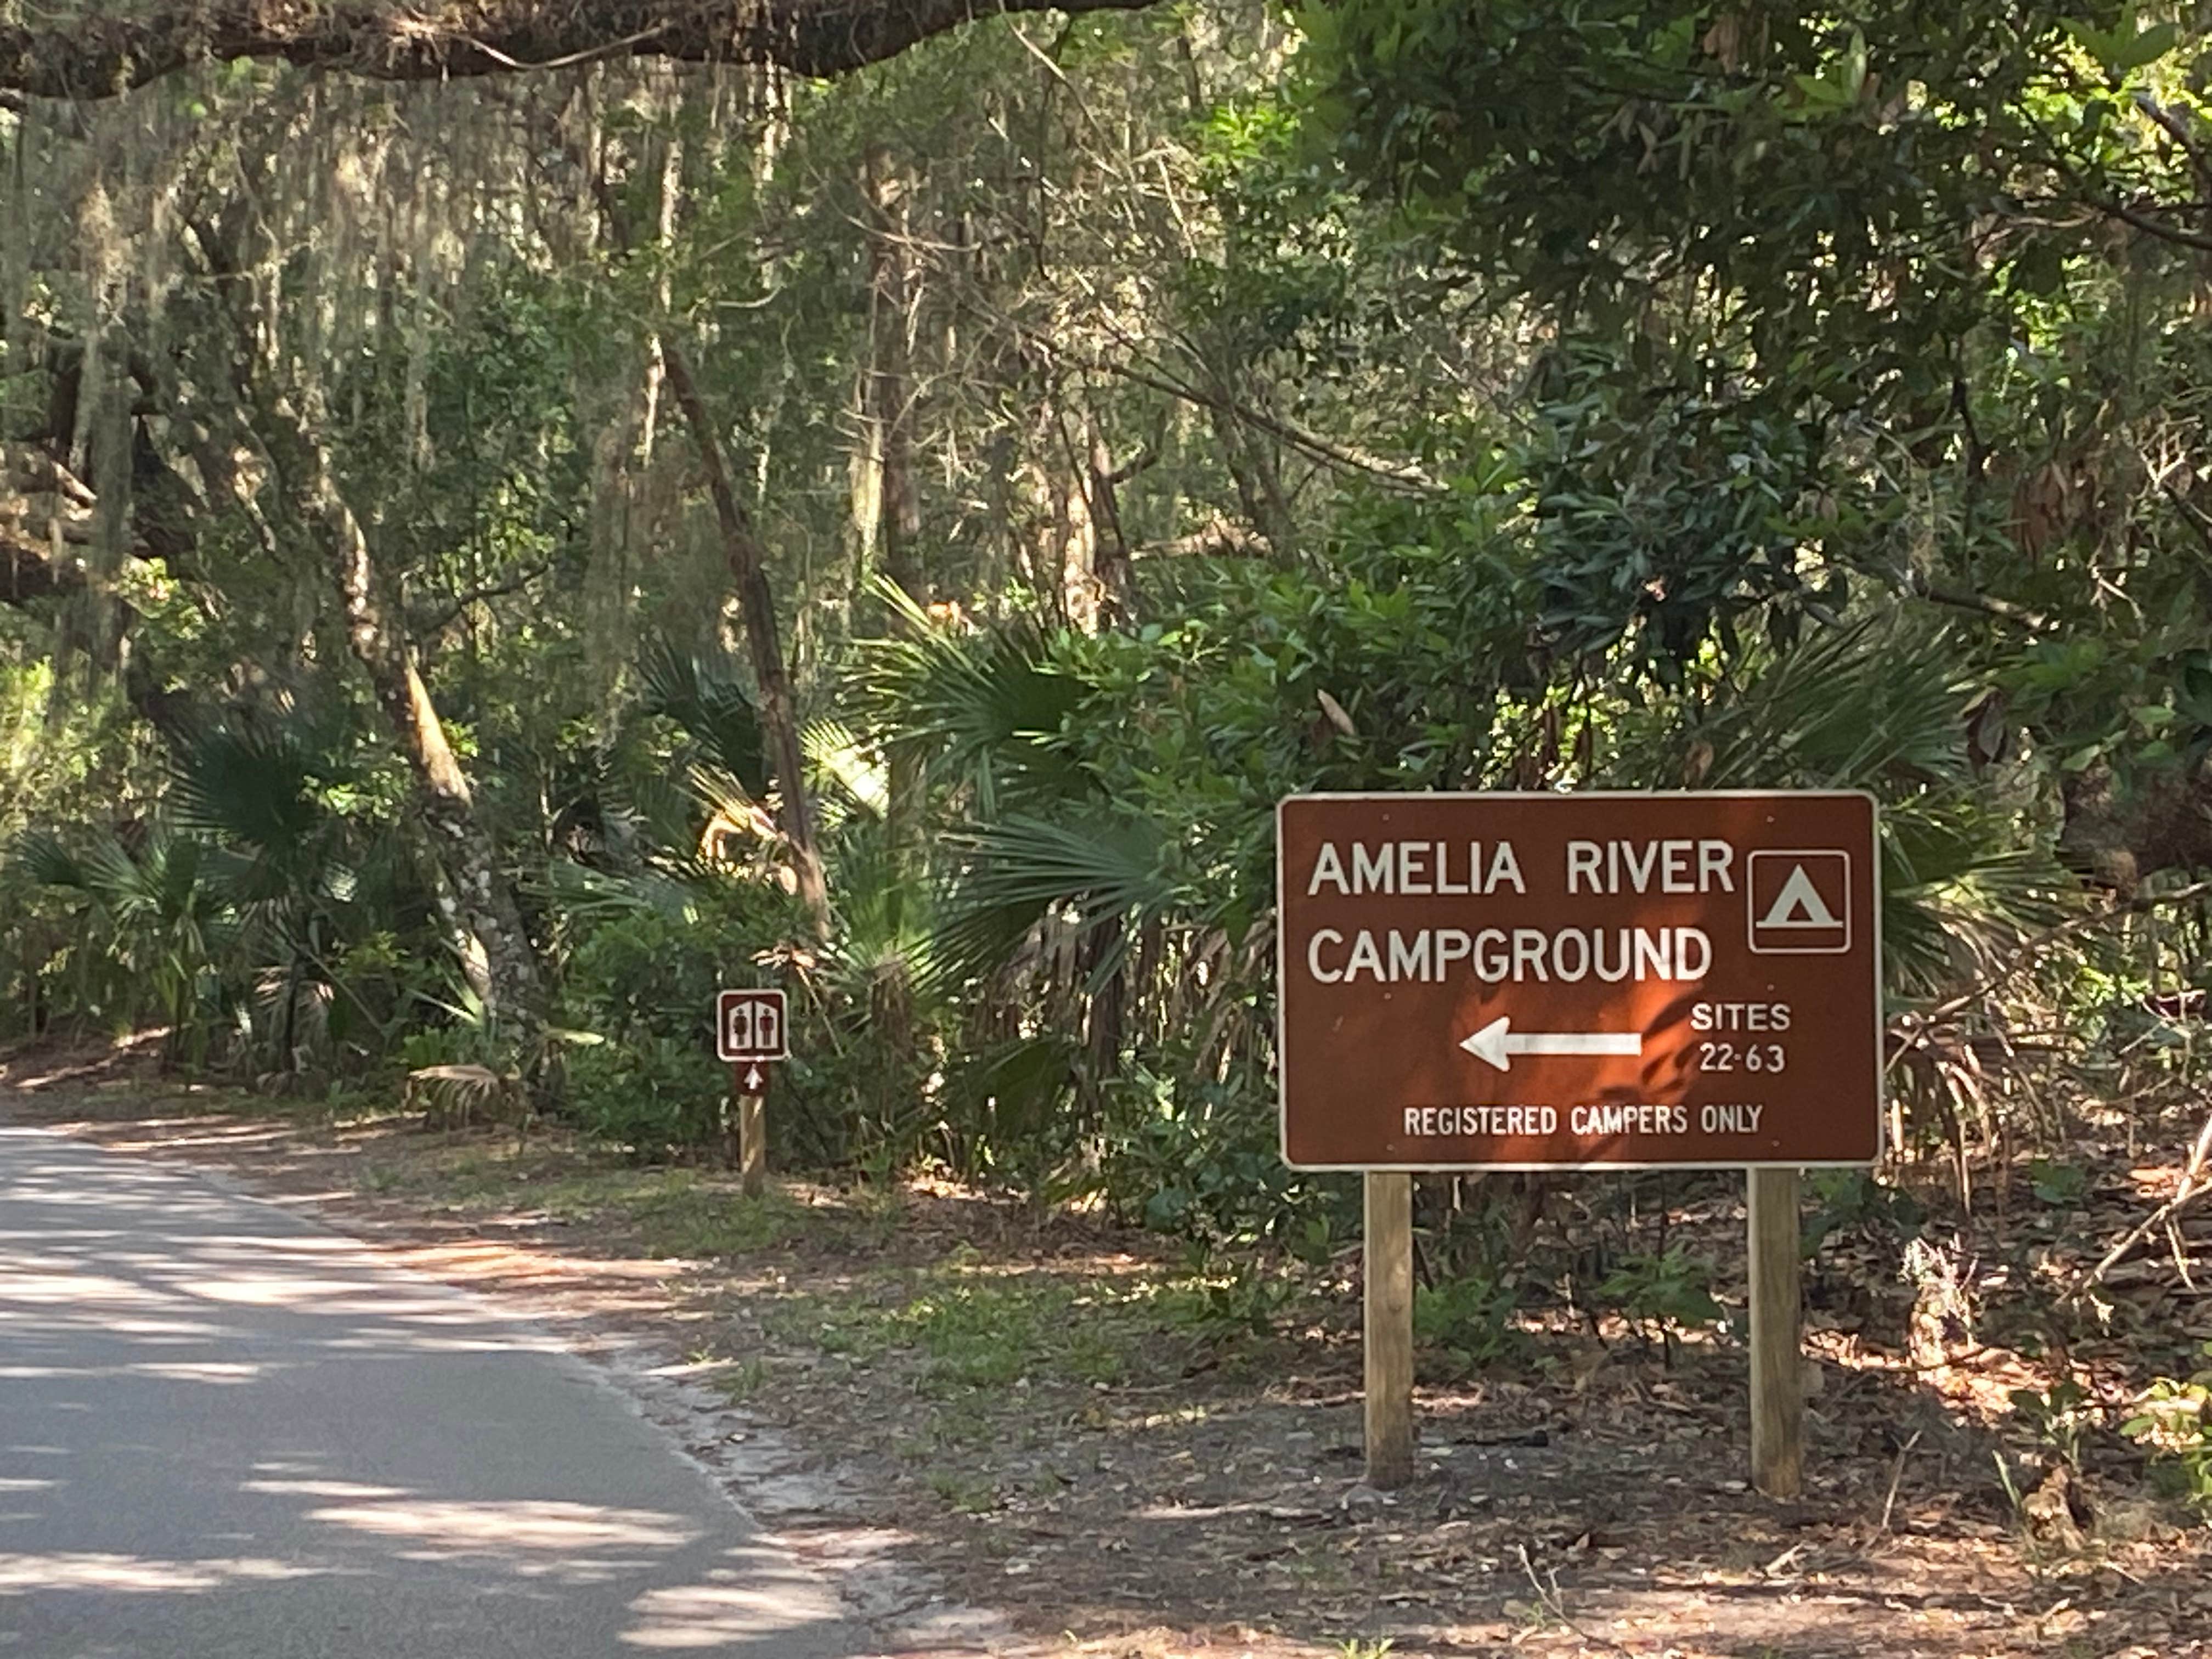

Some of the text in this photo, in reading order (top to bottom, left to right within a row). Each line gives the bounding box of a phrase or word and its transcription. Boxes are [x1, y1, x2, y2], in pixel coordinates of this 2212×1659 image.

[1307, 840, 1734, 895] AMELIA RIVER
[1307, 928, 1713, 984] CAMPGROUND
[1690, 1003, 1791, 1032] SITES
[1700, 1042, 1785, 1073] 22-63
[1404, 1105, 1763, 1136] REGISTERED CAMPERS ONLY
